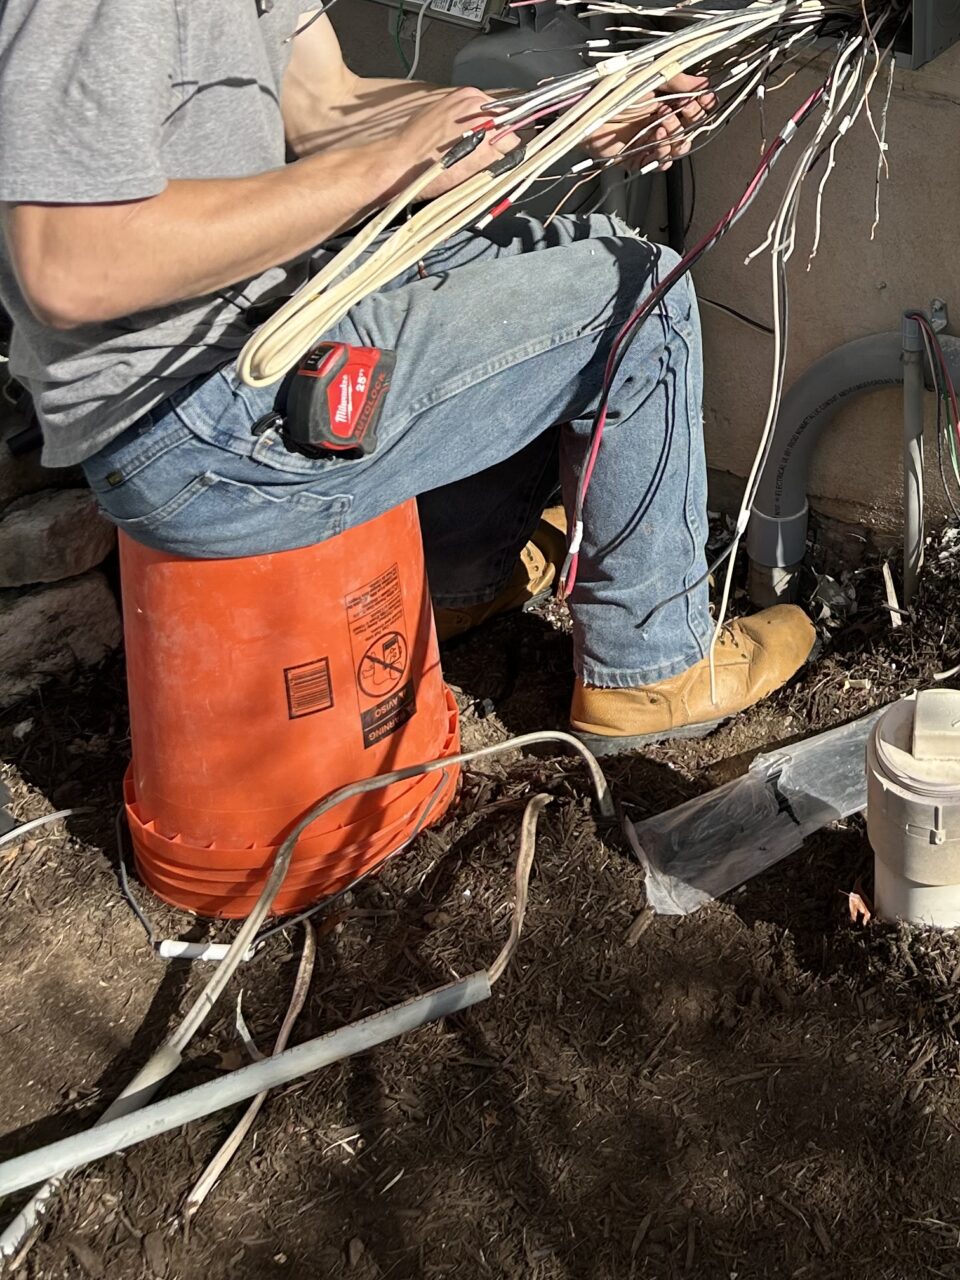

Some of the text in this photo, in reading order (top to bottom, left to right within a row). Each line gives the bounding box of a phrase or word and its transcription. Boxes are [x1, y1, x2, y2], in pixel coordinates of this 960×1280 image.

[334, 374, 349, 423] Milwaukee
[354, 373, 386, 438] AUTOLOCK
[374, 697, 398, 718] AVISO
[368, 715, 401, 741] ARNING
